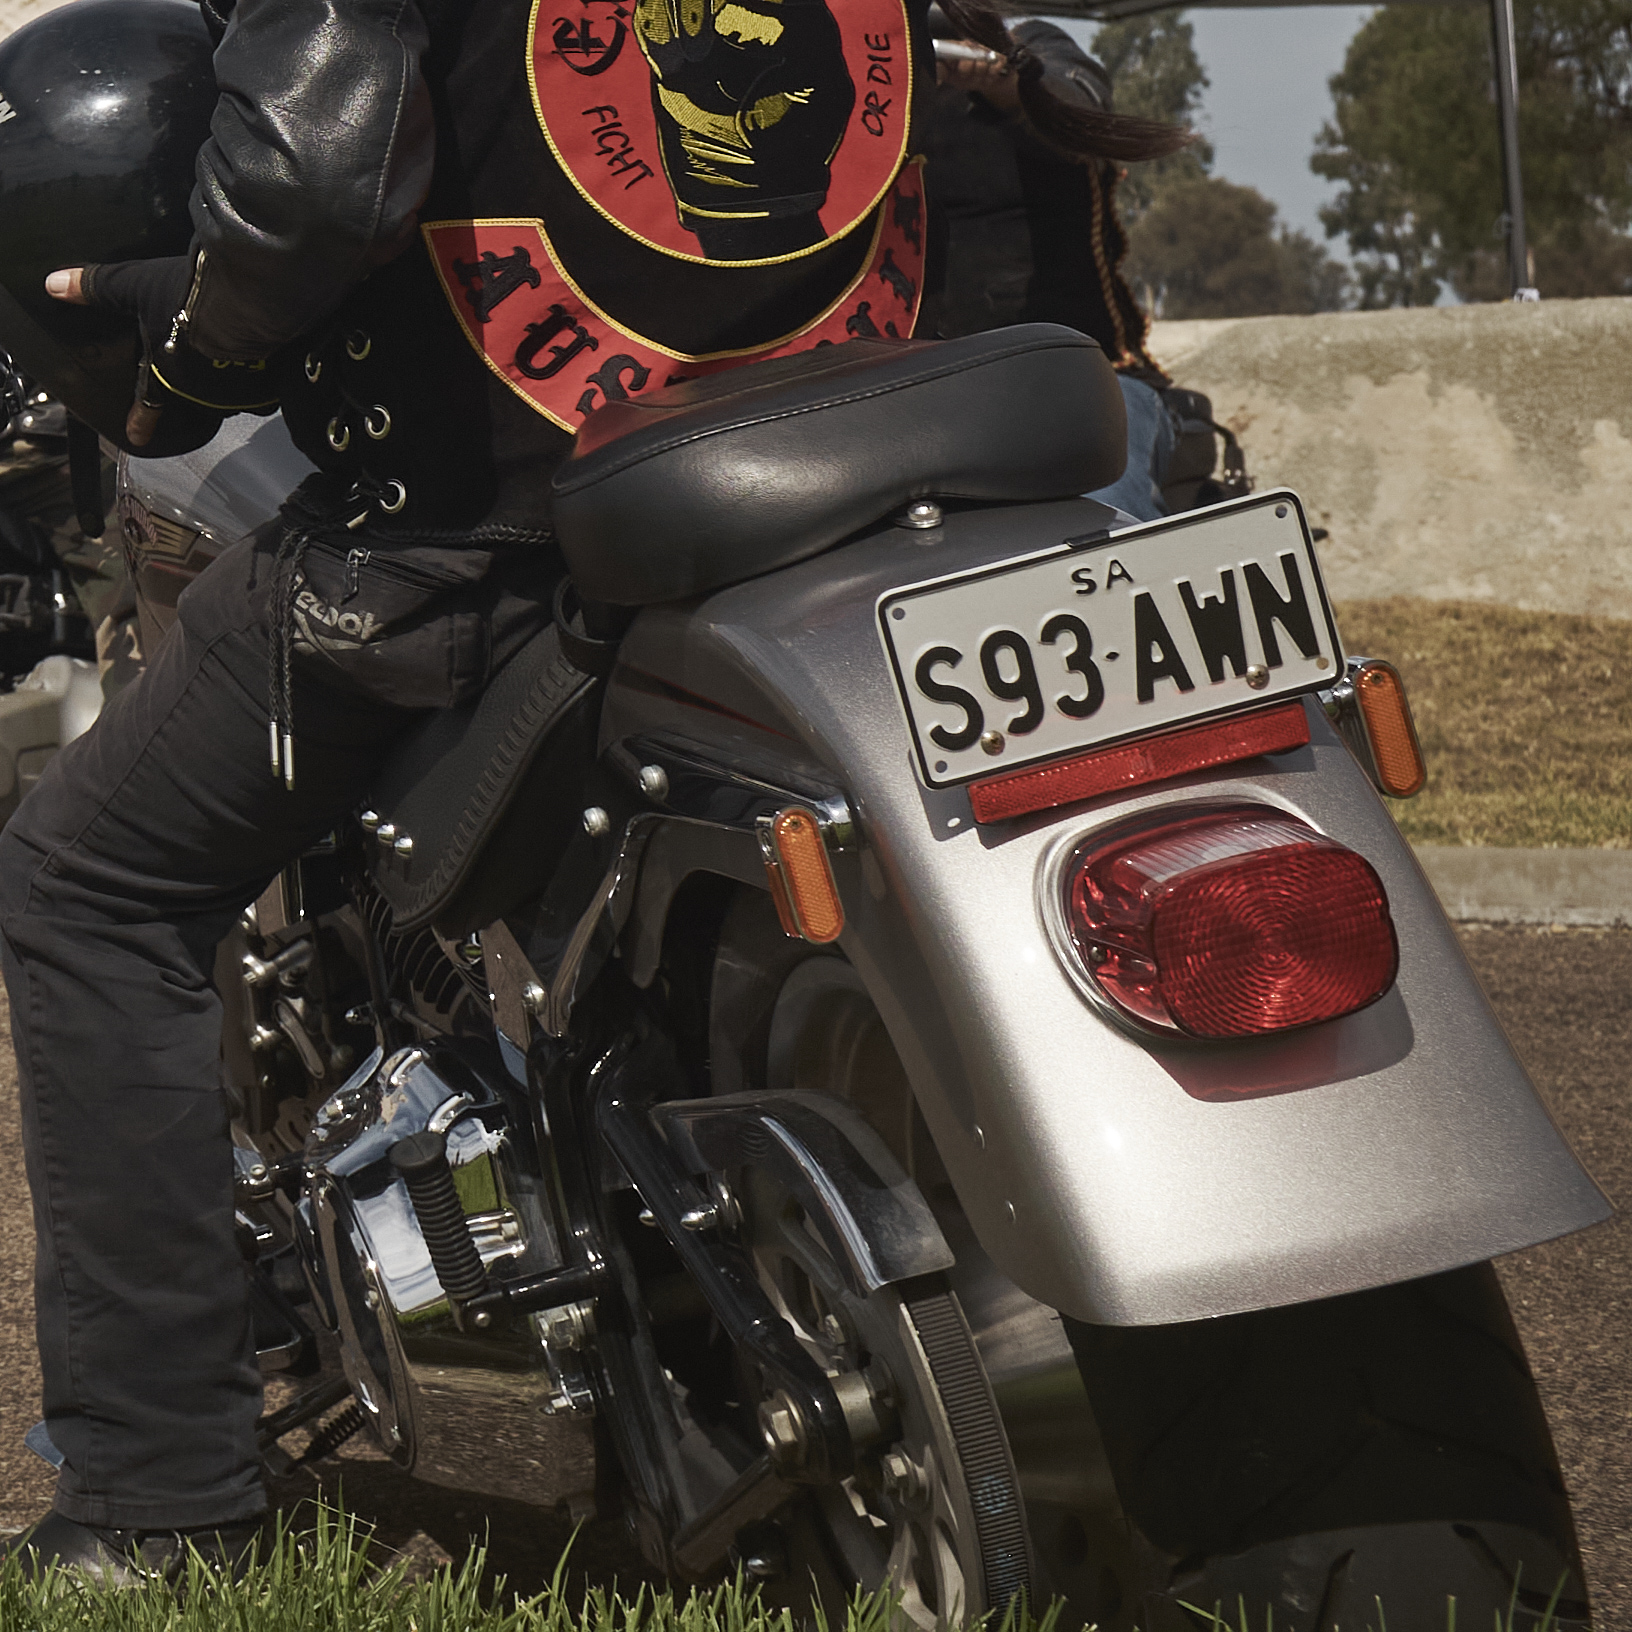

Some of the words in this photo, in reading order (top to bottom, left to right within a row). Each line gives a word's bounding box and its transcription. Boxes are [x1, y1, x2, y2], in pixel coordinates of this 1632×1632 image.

[864, 33, 893, 86] DIE
[861, 90, 892, 137] OR
[581, 104, 655, 190] FIGHT
[1071, 558, 1135, 595] SA
